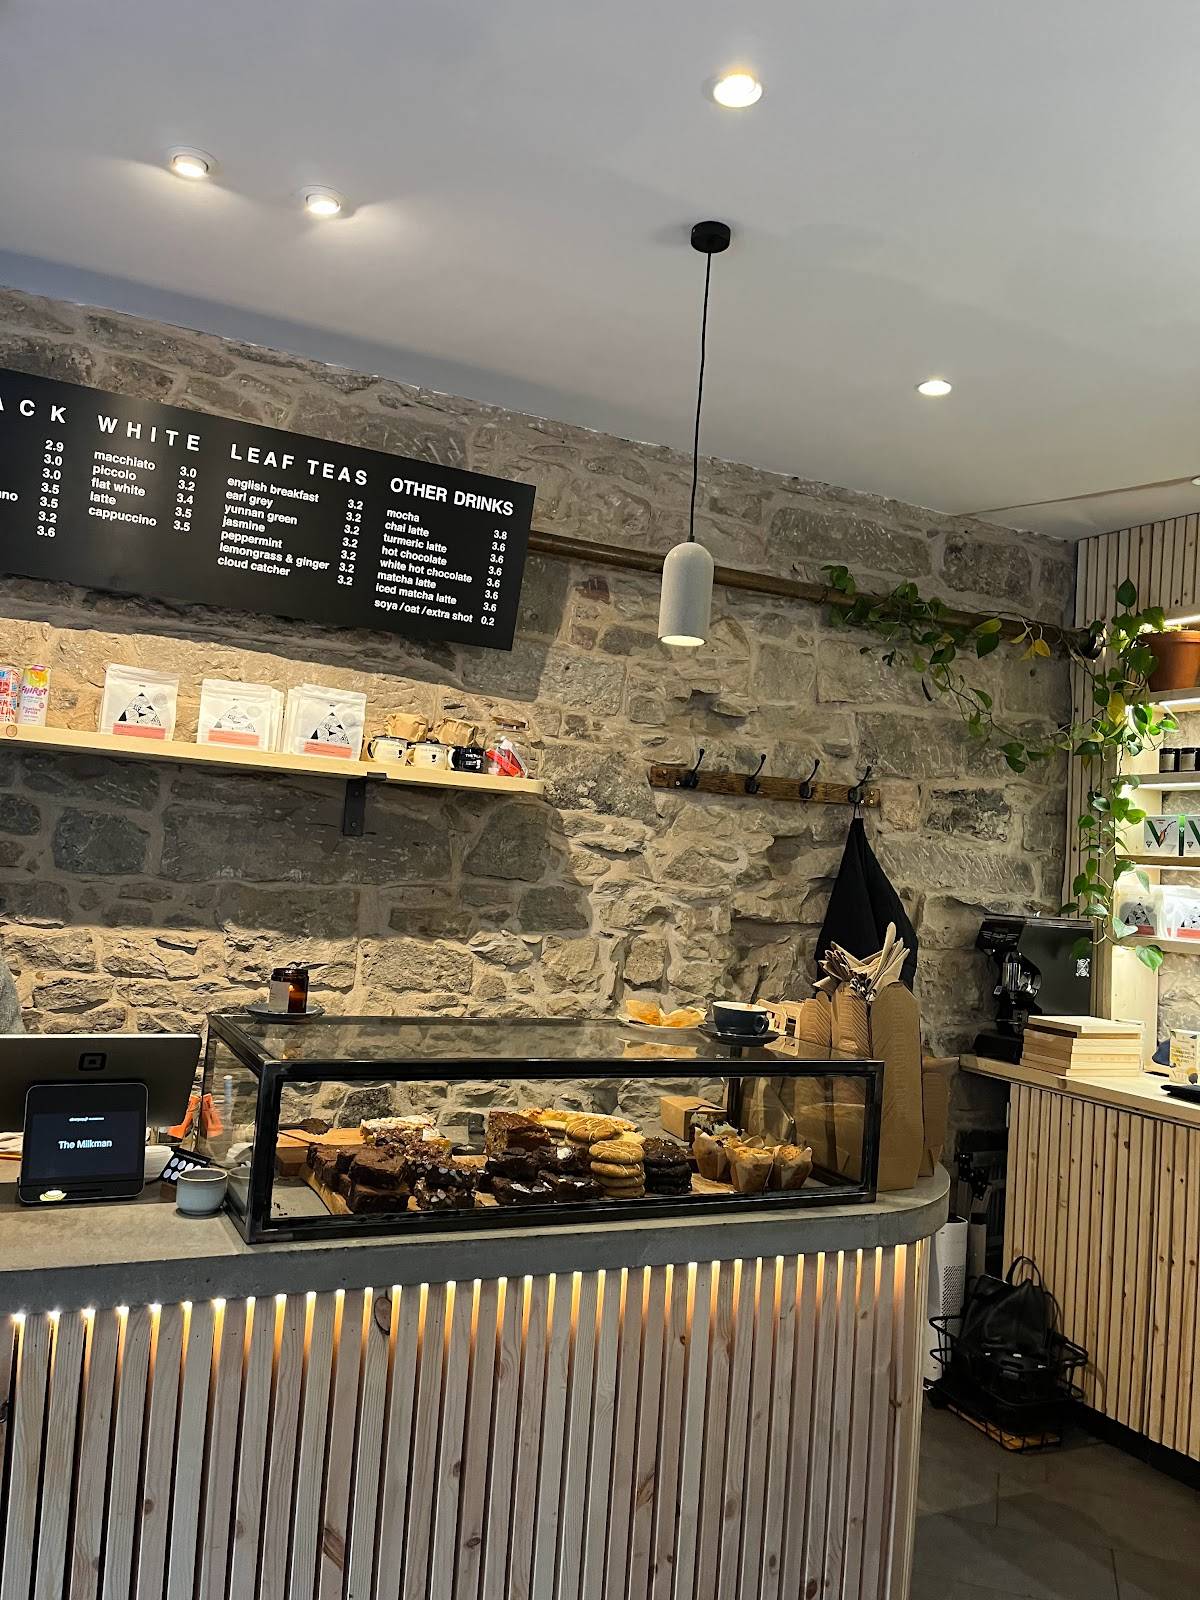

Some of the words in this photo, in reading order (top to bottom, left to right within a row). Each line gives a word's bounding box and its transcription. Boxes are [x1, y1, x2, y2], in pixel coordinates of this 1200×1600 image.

[0, 397, 66, 423] CK
[45, 440, 64, 452] 2.9
[98, 415, 200, 451] WHITE
[42, 468, 61, 480] 3.0
[44, 454, 62, 466] 3.0
[94, 451, 155, 470] macchiato
[180, 466, 197, 478] 3.0
[231, 444, 294, 469] LEAF
[307, 459, 367, 485] TEAS
[41, 482, 59, 494] 3.5
[91, 477, 111, 490] flat
[113, 483, 145, 496] white
[176, 493, 193, 505] 3.4
[92, 464, 137, 481] piccolo
[178, 479, 195, 491] 3.2
[40, 496, 58, 508] 3.5
[90, 491, 116, 505] latte
[175, 507, 192, 518] 3.5
[226, 491, 247, 502] earl
[249, 496, 273, 509] grey
[346, 512, 361, 523] 3.2
[227, 478, 267, 492] english
[270, 484, 319, 502] breakfast
[348, 499, 363, 510] 3.2
[390, 478, 447, 502] OTHER
[454, 491, 513, 516] DRINKS
[37, 525, 55, 537] 3.6
[38, 511, 57, 523] 3.2
[88, 507, 157, 526] cappuccino
[173, 520, 190, 532] 3.5
[224, 504, 264, 519] yunnan
[267, 513, 297, 525] green
[344, 524, 360, 535] 3.2
[387, 510, 419, 522] mocha
[494, 530, 507, 540] 3.8
[222, 515, 265, 532] jasmine
[342, 537, 358, 548] 3.2
[385, 521, 406, 532] chai
[408, 525, 429, 537] latte
[492, 542, 506, 552] 3.6
[219, 542, 283, 562] lemongrass
[285, 554, 293, 564] &
[296, 557, 330, 570] ginger
[339, 562, 354, 573] 3.2
[221, 531, 283, 548] peppermint
[341, 550, 356, 561] 3.2
[383, 533, 424, 548] turmeric
[426, 541, 447, 553] latte
[490, 554, 504, 564] 3.6
[217, 556, 248, 569] cloud
[250, 563, 290, 576] catcher
[337, 575, 353, 586] 3.2
[380, 559, 406, 571] white
[408, 563, 425, 574] hot
[427, 567, 472, 583] chocolate
[486, 578, 500, 588] 3.6
[382, 545, 398, 557] hot
[400, 550, 447, 566] chocolate
[488, 566, 502, 576] 3.6
[376, 583, 397, 594] iced
[399, 588, 434, 601] matcha
[436, 593, 457, 604] latte
[483, 602, 497, 612] 3.6
[377, 572, 413, 585] matcha
[415, 577, 436, 589] latte
[485, 590, 498, 600] 3.6
[374, 600, 398, 611] soya
[452, 612, 473, 623] shot
[481, 616, 495, 626] 0.2
[58, 1140, 75, 1149] The
[77, 1139, 112, 1148] Milkman
